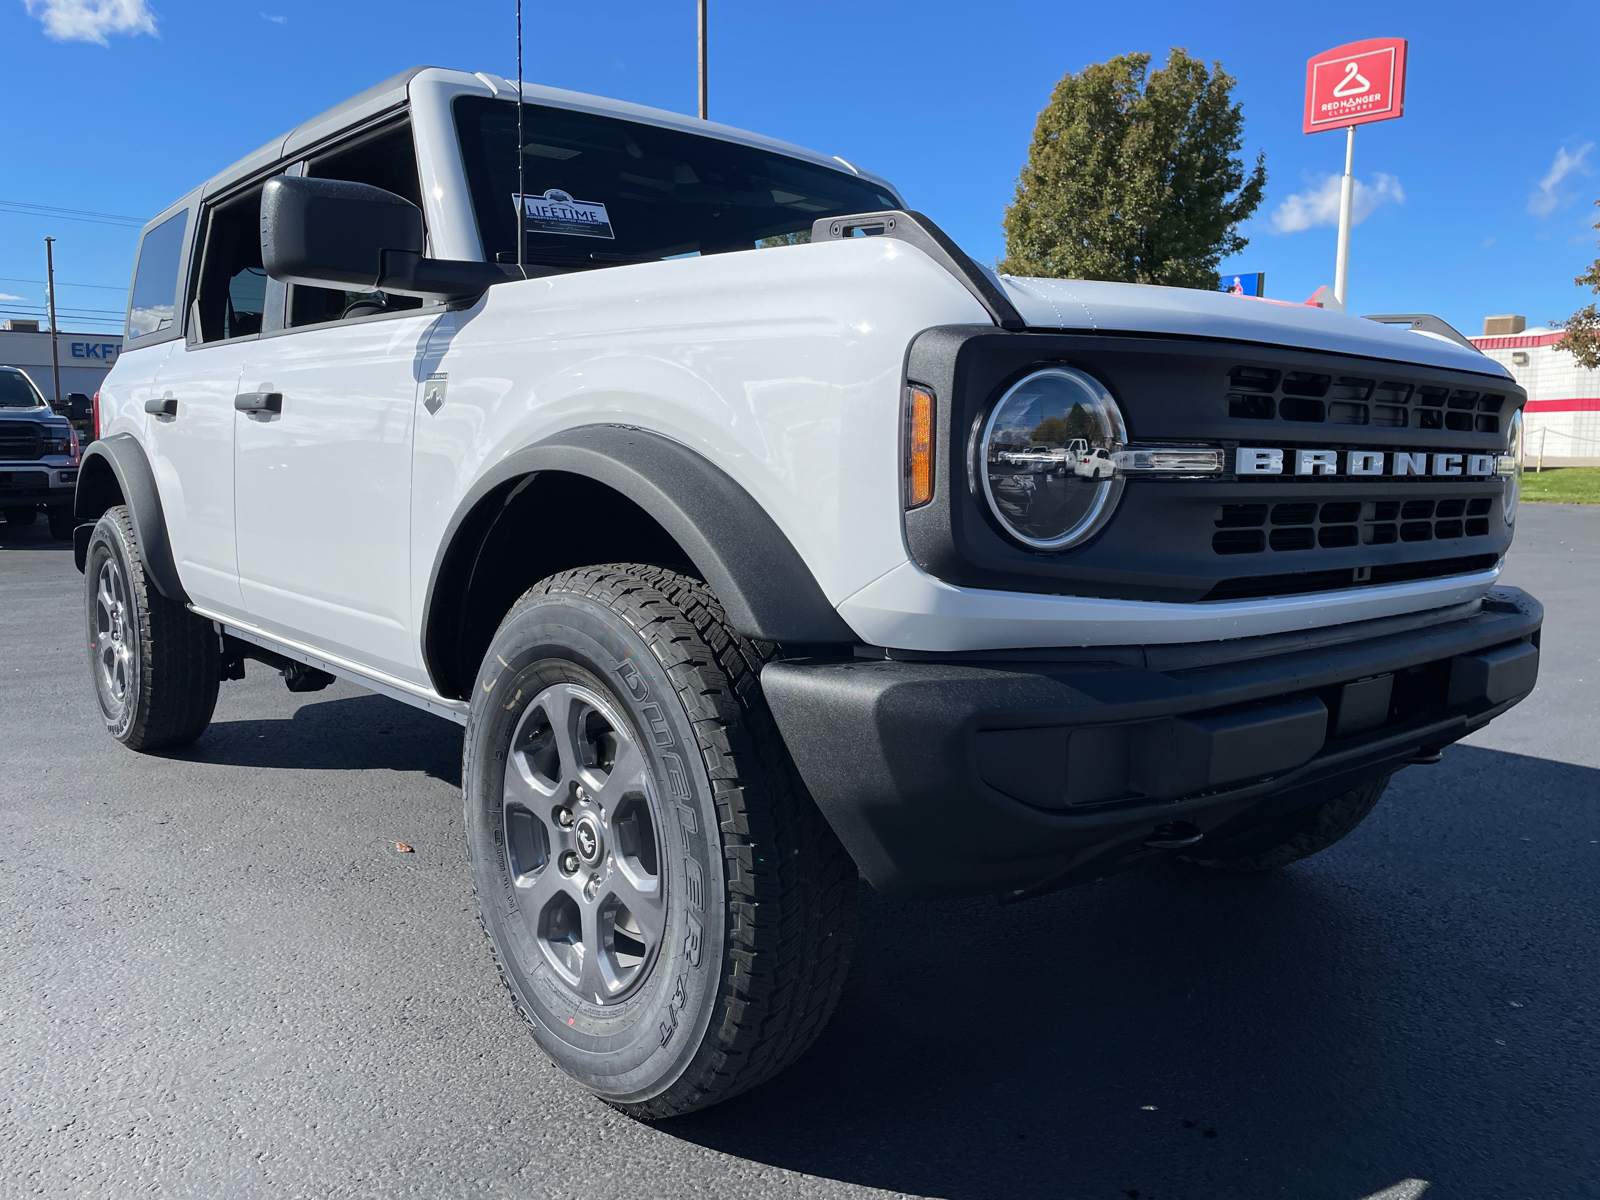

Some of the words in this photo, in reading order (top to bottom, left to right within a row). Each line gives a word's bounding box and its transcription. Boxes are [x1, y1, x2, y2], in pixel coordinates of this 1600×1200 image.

[1321, 102, 1339, 111] RED
[1329, 104, 1372, 116] CLEANERS
[527, 205, 598, 221] LIFETIME
[1236, 446, 1494, 476] BRONCO
